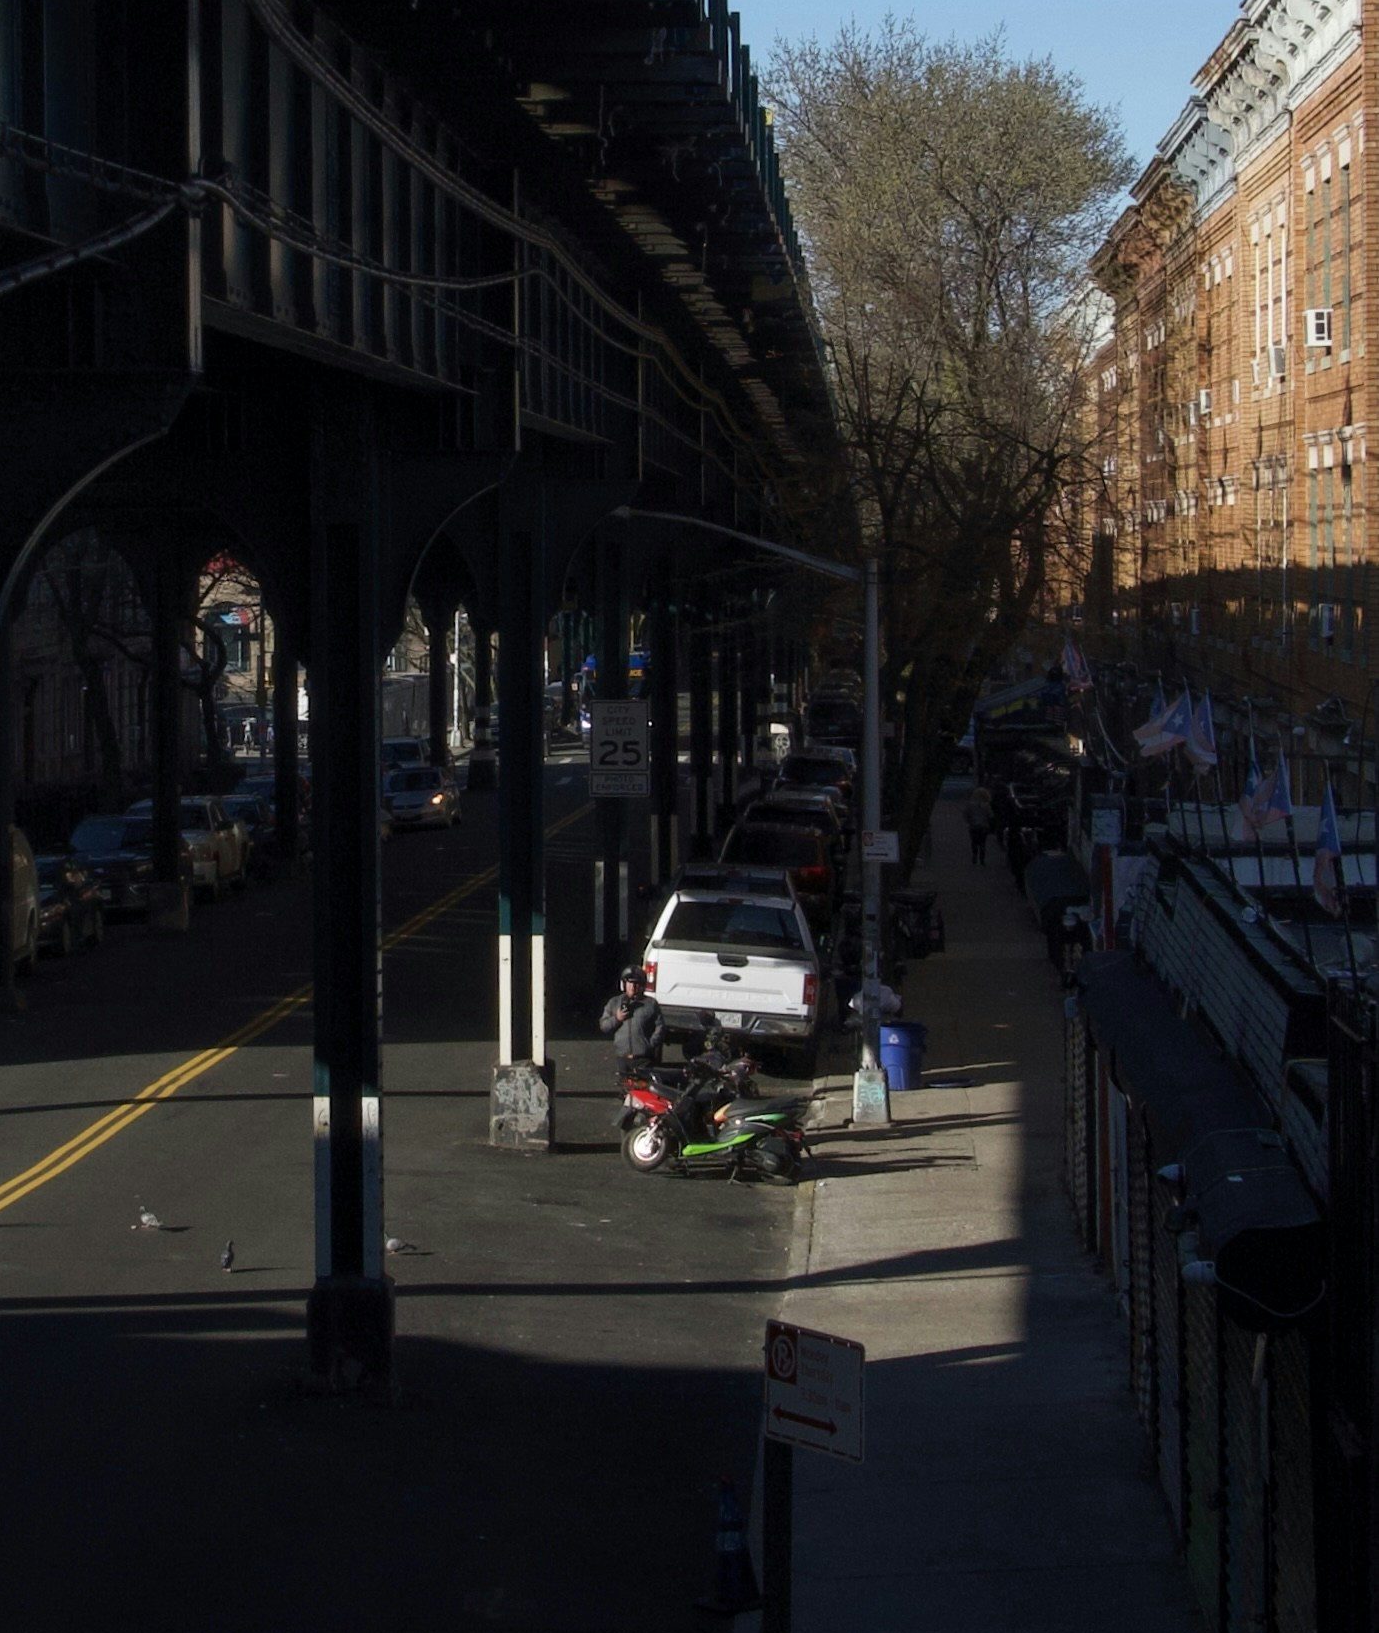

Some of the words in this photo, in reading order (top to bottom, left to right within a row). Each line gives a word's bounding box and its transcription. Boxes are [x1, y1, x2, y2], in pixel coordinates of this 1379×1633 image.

[607, 706, 631, 715] CITY
[602, 716, 637, 726] SPEED
[605, 727, 633, 737] LIMIT
[599, 739, 642, 767] 25
